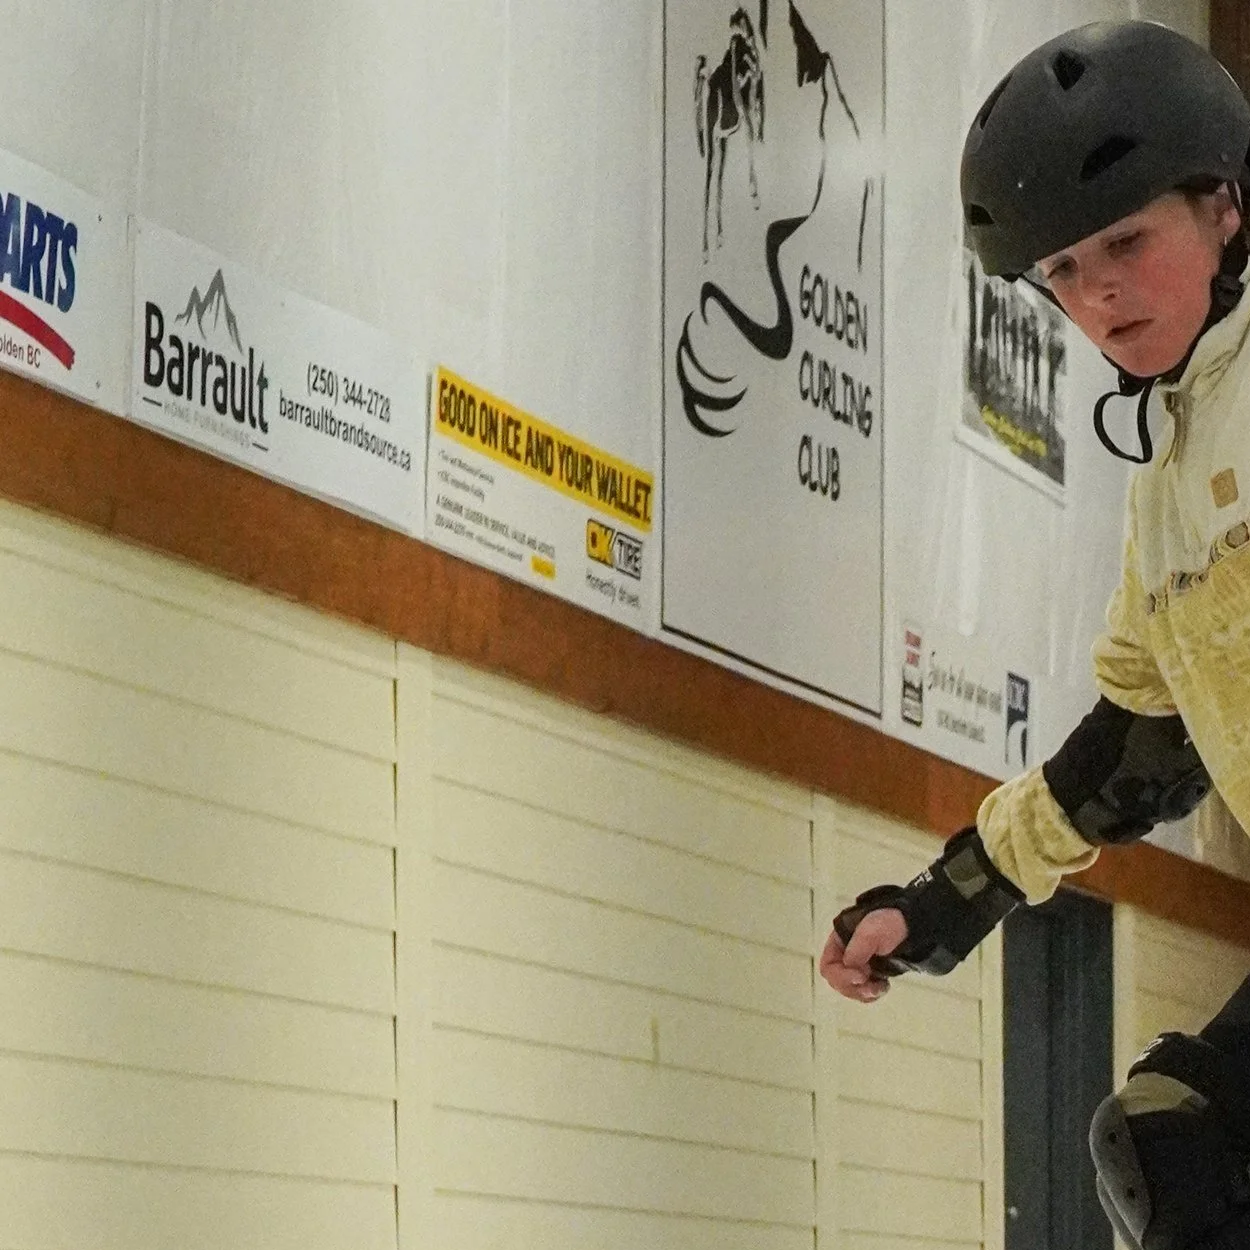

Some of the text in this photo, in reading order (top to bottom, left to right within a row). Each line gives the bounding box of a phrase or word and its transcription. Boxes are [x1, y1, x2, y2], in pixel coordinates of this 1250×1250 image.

[0, 192, 78, 313] ARTS
[800, 263, 867, 354] GOLDEN
[27, 344, 41, 368] BC
[143, 301, 269, 434] Barrault
[307, 361, 338, 406] (250)
[799, 350, 872, 437] CURLING
[280, 388, 411, 471] barraultbrandsource.ca
[439, 378, 476, 437] GOOD
[479, 402, 498, 450] ON
[501, 411, 521, 462] ICE
[524, 426, 554, 477] AND
[558, 441, 593, 497] YOUR
[798, 434, 840, 501] CLUB
